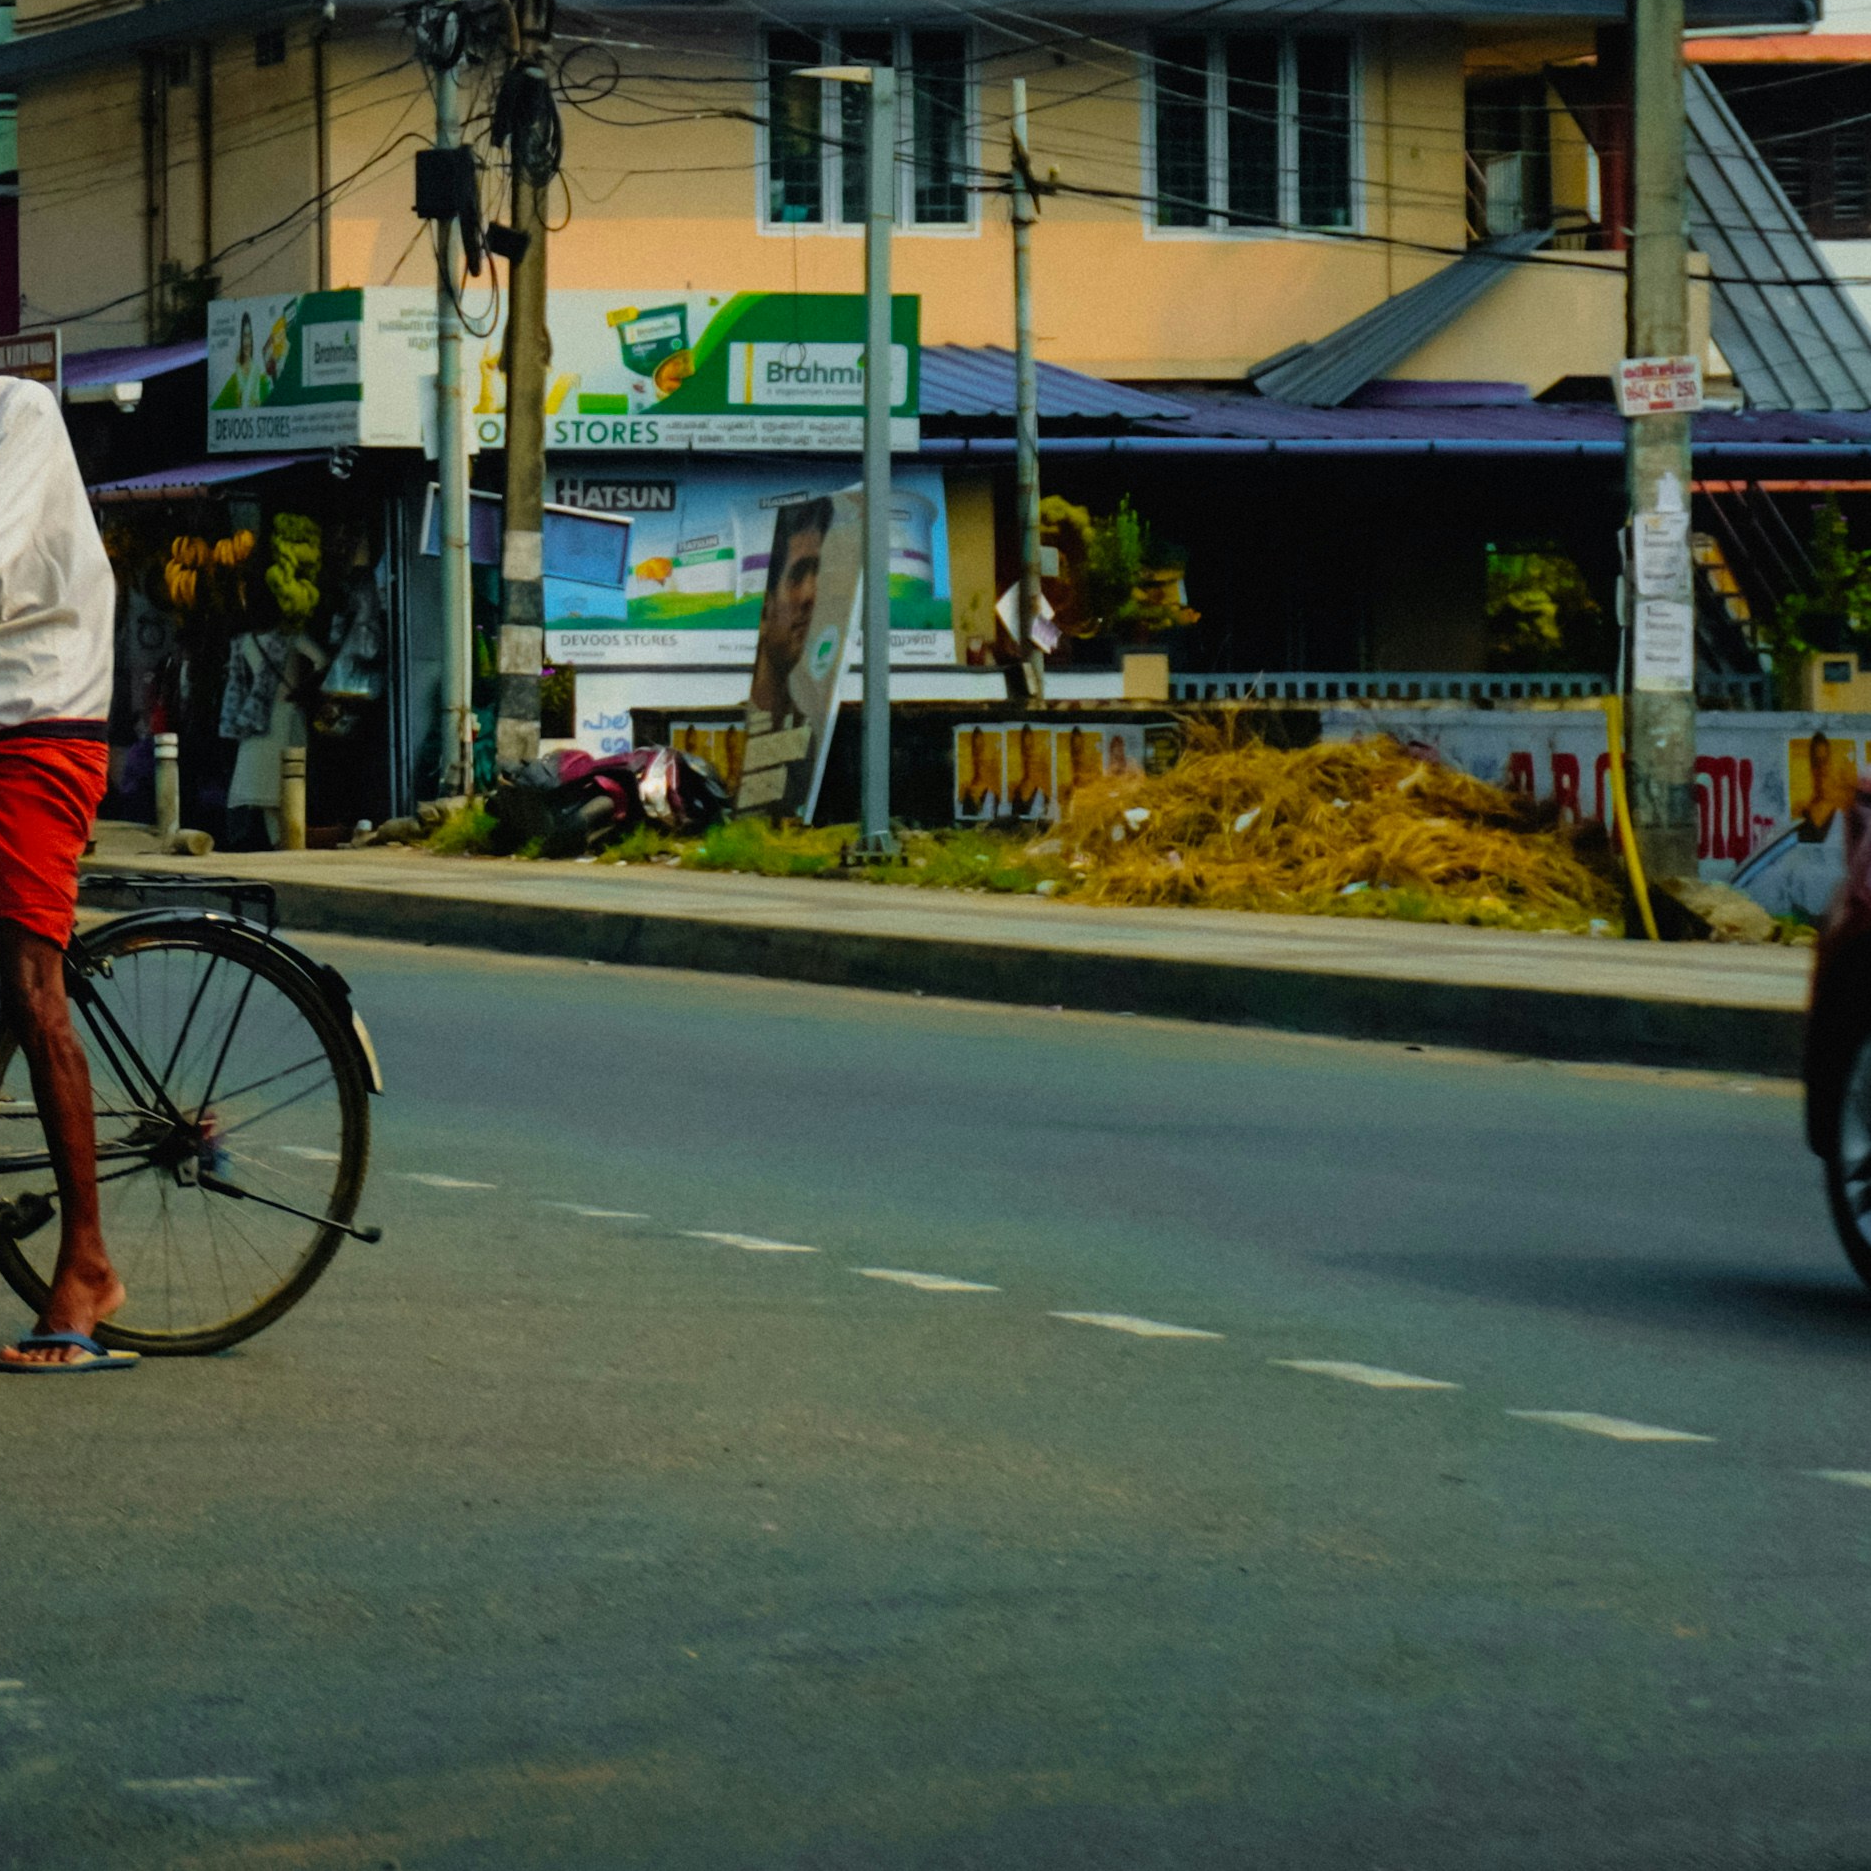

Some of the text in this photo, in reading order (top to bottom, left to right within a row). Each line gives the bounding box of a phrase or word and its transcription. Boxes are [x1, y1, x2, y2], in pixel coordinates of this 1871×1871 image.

[215, 416, 254, 441] DEVOOS
[256, 415, 291, 439] STORES
[554, 420, 659, 444] STORES
[559, 479, 673, 510] HATSUN
[560, 634, 679, 647] DEVOOS STORES
